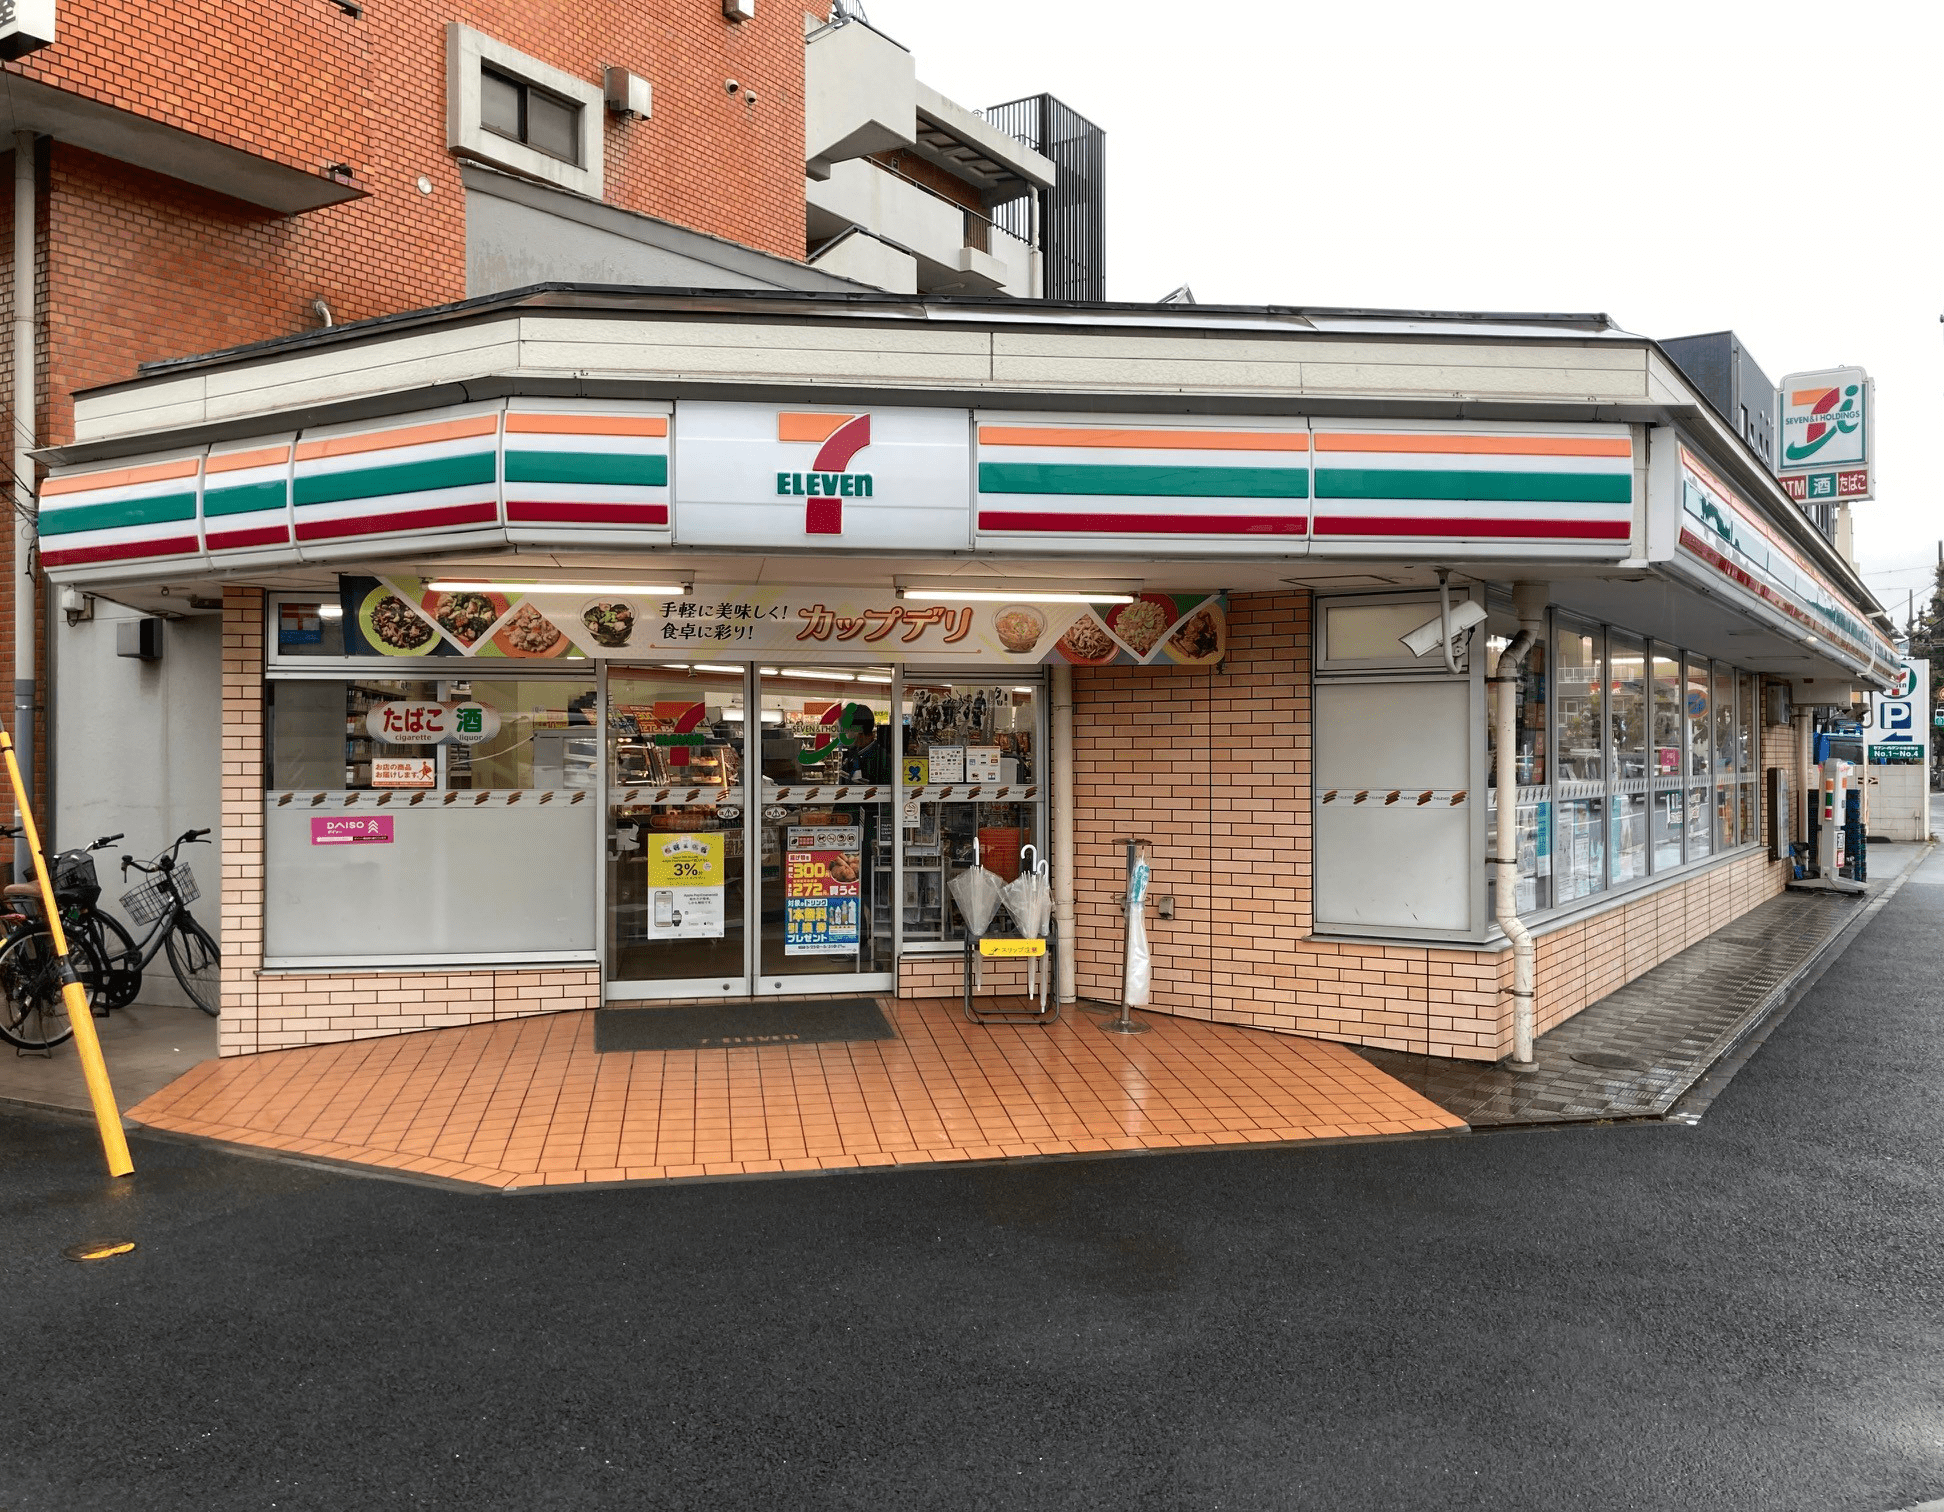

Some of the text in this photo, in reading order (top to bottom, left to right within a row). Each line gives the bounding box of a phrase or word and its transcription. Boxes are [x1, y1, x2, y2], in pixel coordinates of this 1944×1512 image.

[1820, 410, 1860, 421] HOLDINGS
[1813, 477, 1831, 495] 酒
[1839, 474, 1866, 492] たばこ
[659, 601, 788, 620] 手軽に美味しく!
[660, 621, 754, 640] 食卓に彩り!
[796, 603, 974, 644] カップデリ
[383, 706, 482, 733] たばこ 酒
[1883, 702, 1910, 729] P
[395, 733, 483, 742] cigarette liquor
[375, 763, 412, 771] お店の商品
[326, 821, 365, 829] DAISO
[787, 933, 828, 943] プレゼント
